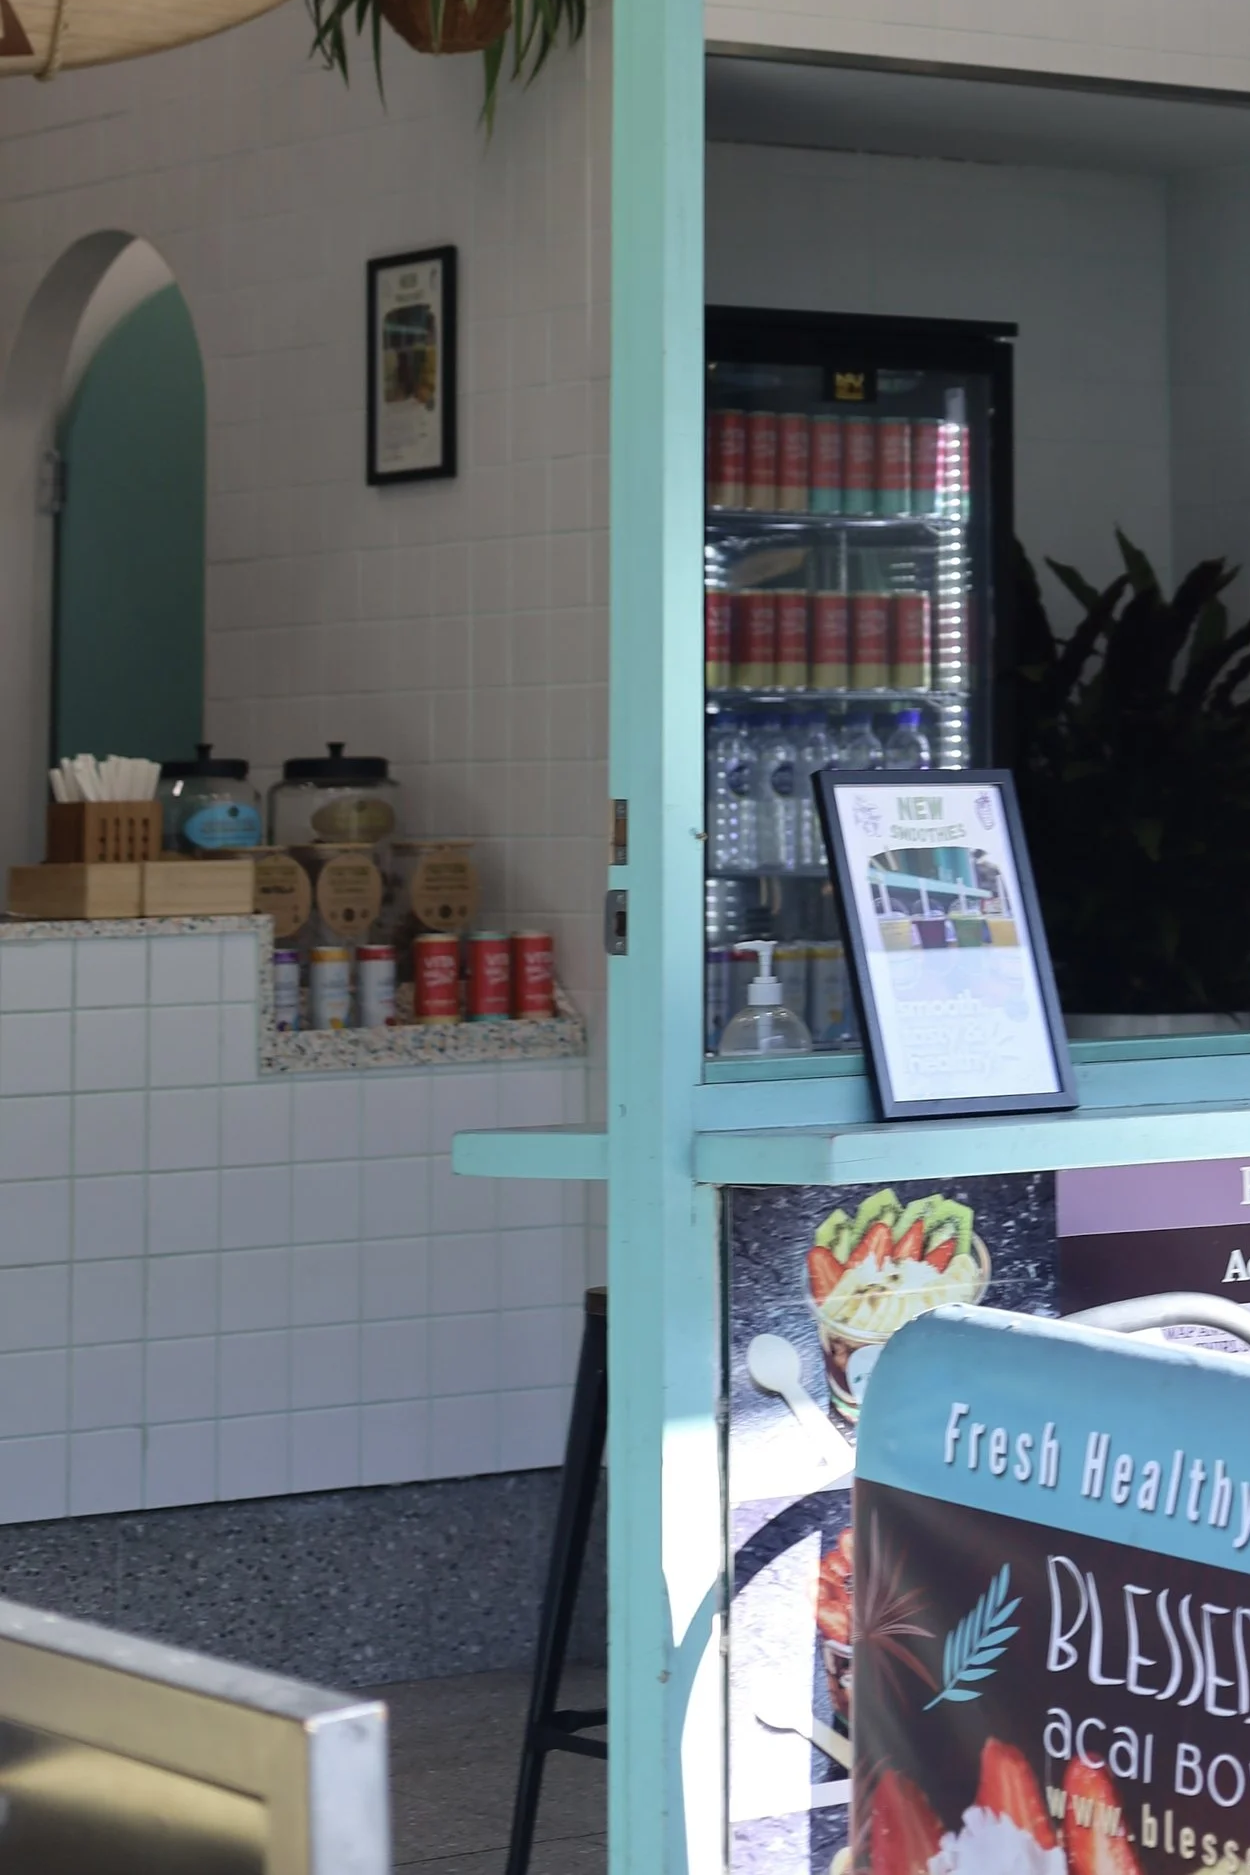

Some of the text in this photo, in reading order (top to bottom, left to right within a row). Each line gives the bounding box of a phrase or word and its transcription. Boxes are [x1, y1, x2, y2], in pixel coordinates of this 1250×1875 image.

[896, 796, 943, 821] NEW
[889, 823, 966, 842] SMOOTHIES
[943, 1401, 1060, 1488] Fresh
